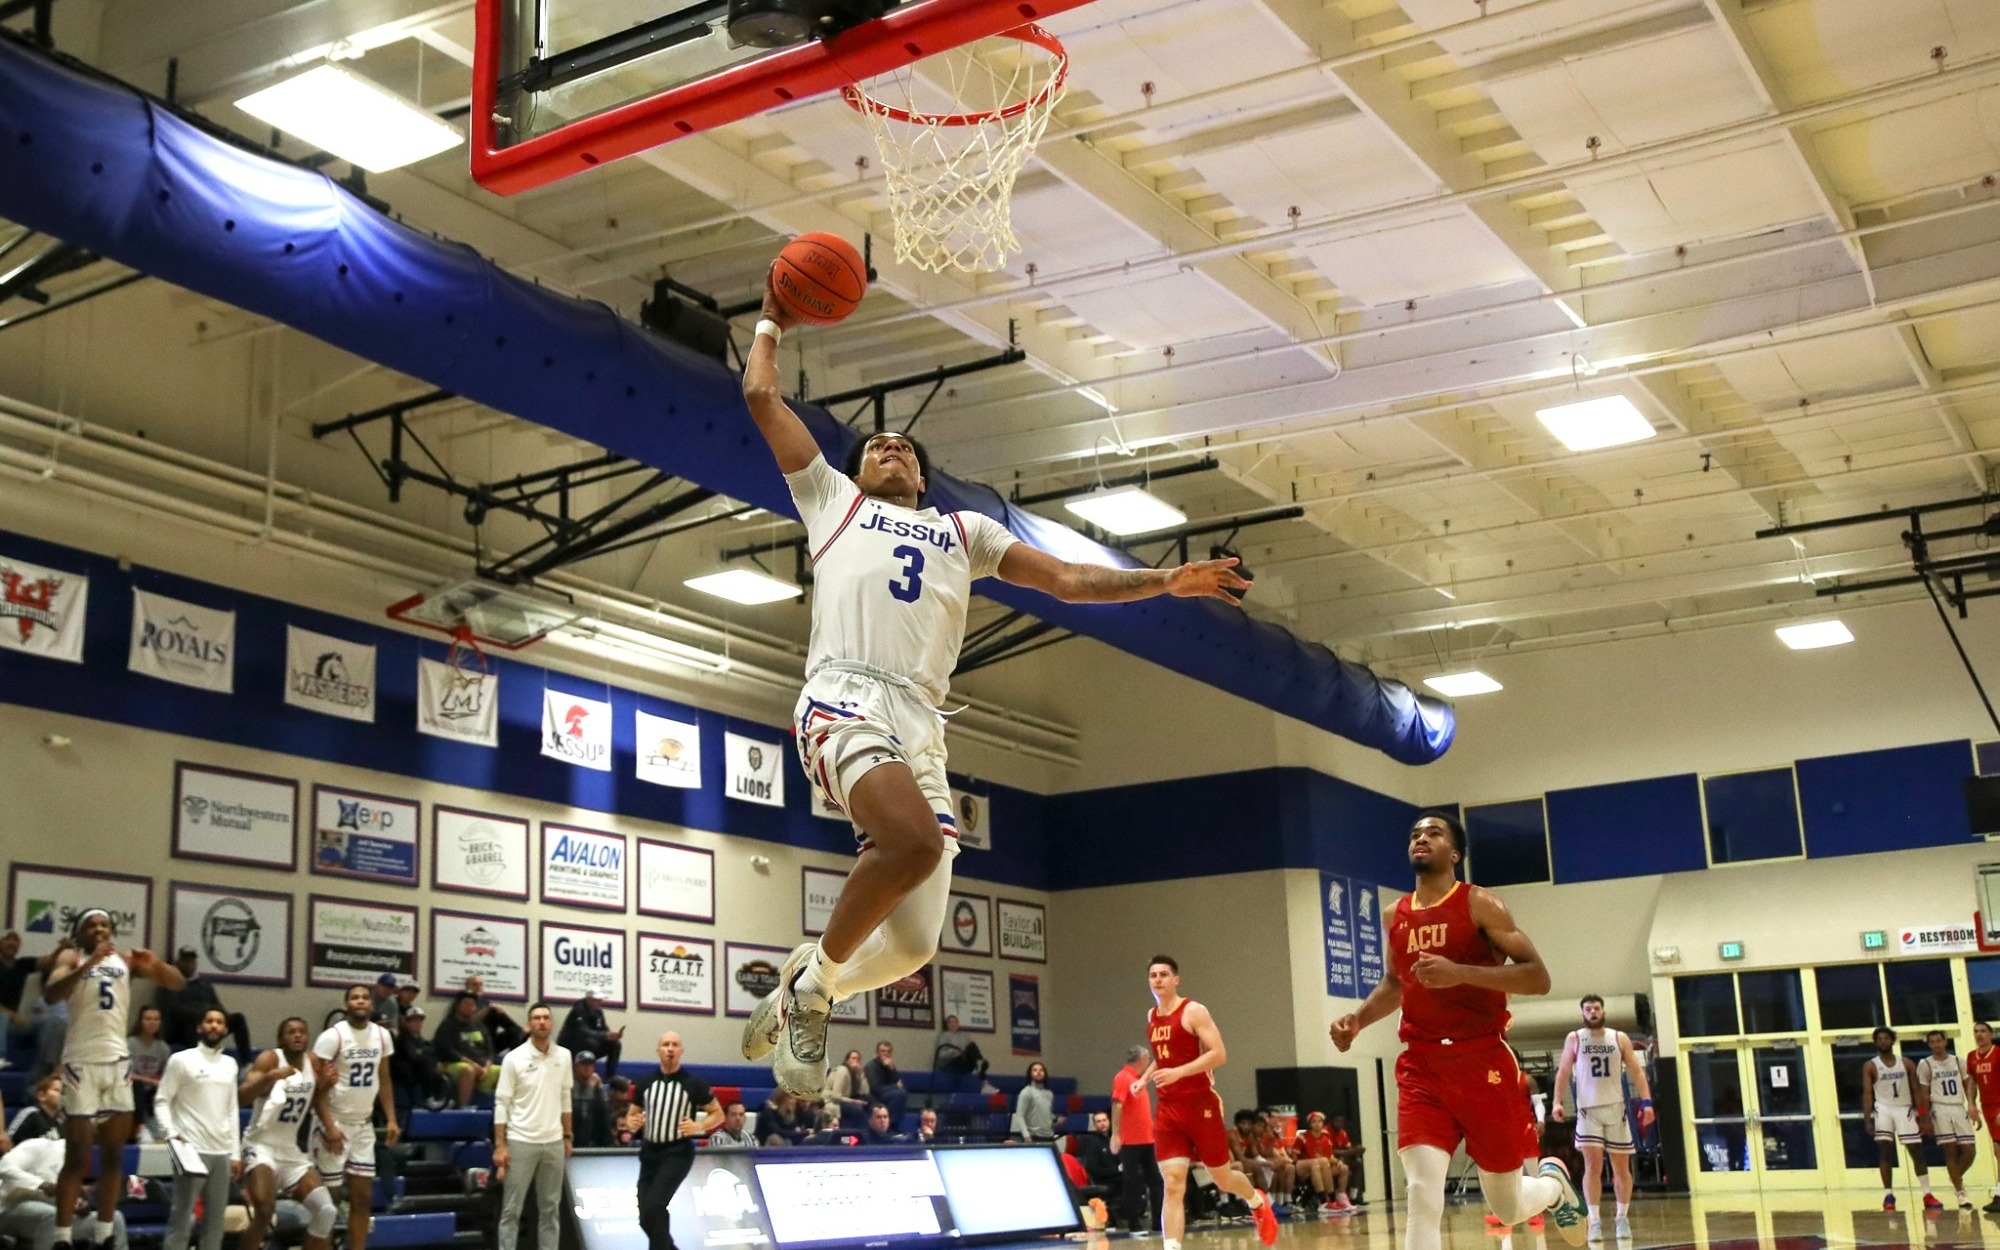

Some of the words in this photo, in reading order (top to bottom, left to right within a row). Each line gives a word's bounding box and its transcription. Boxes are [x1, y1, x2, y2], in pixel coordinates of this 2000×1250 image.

[779, 271, 835, 315] SPALDING
[888, 544, 925, 603] 3
[141, 621, 226, 664] ROYALS
[736, 774, 772, 799] LIONS
[550, 835, 621, 870] AVALON
[1407, 923, 1448, 954] ACU
[1920, 929, 1977, 943] RESTROOM
[554, 936, 612, 969] Guild
[650, 957, 704, 977] S.C.A.T.T.
[554, 970, 613, 987] mortgage
[98, 981, 114, 1010] 5
[881, 985, 930, 1004] PIZZA
[1151, 1025, 1172, 1042] ACU
[345, 1048, 380, 1059] JESSUP
[1583, 1045, 1615, 1054] JESSUP
[350, 1062, 374, 1087] 22
[1591, 1057, 1610, 1077] 21
[1976, 1063, 1992, 1073] ACU
[1891, 1081, 1899, 1098] 1
[1941, 1080, 1958, 1096] 10
[279, 1098, 306, 1122] 23
